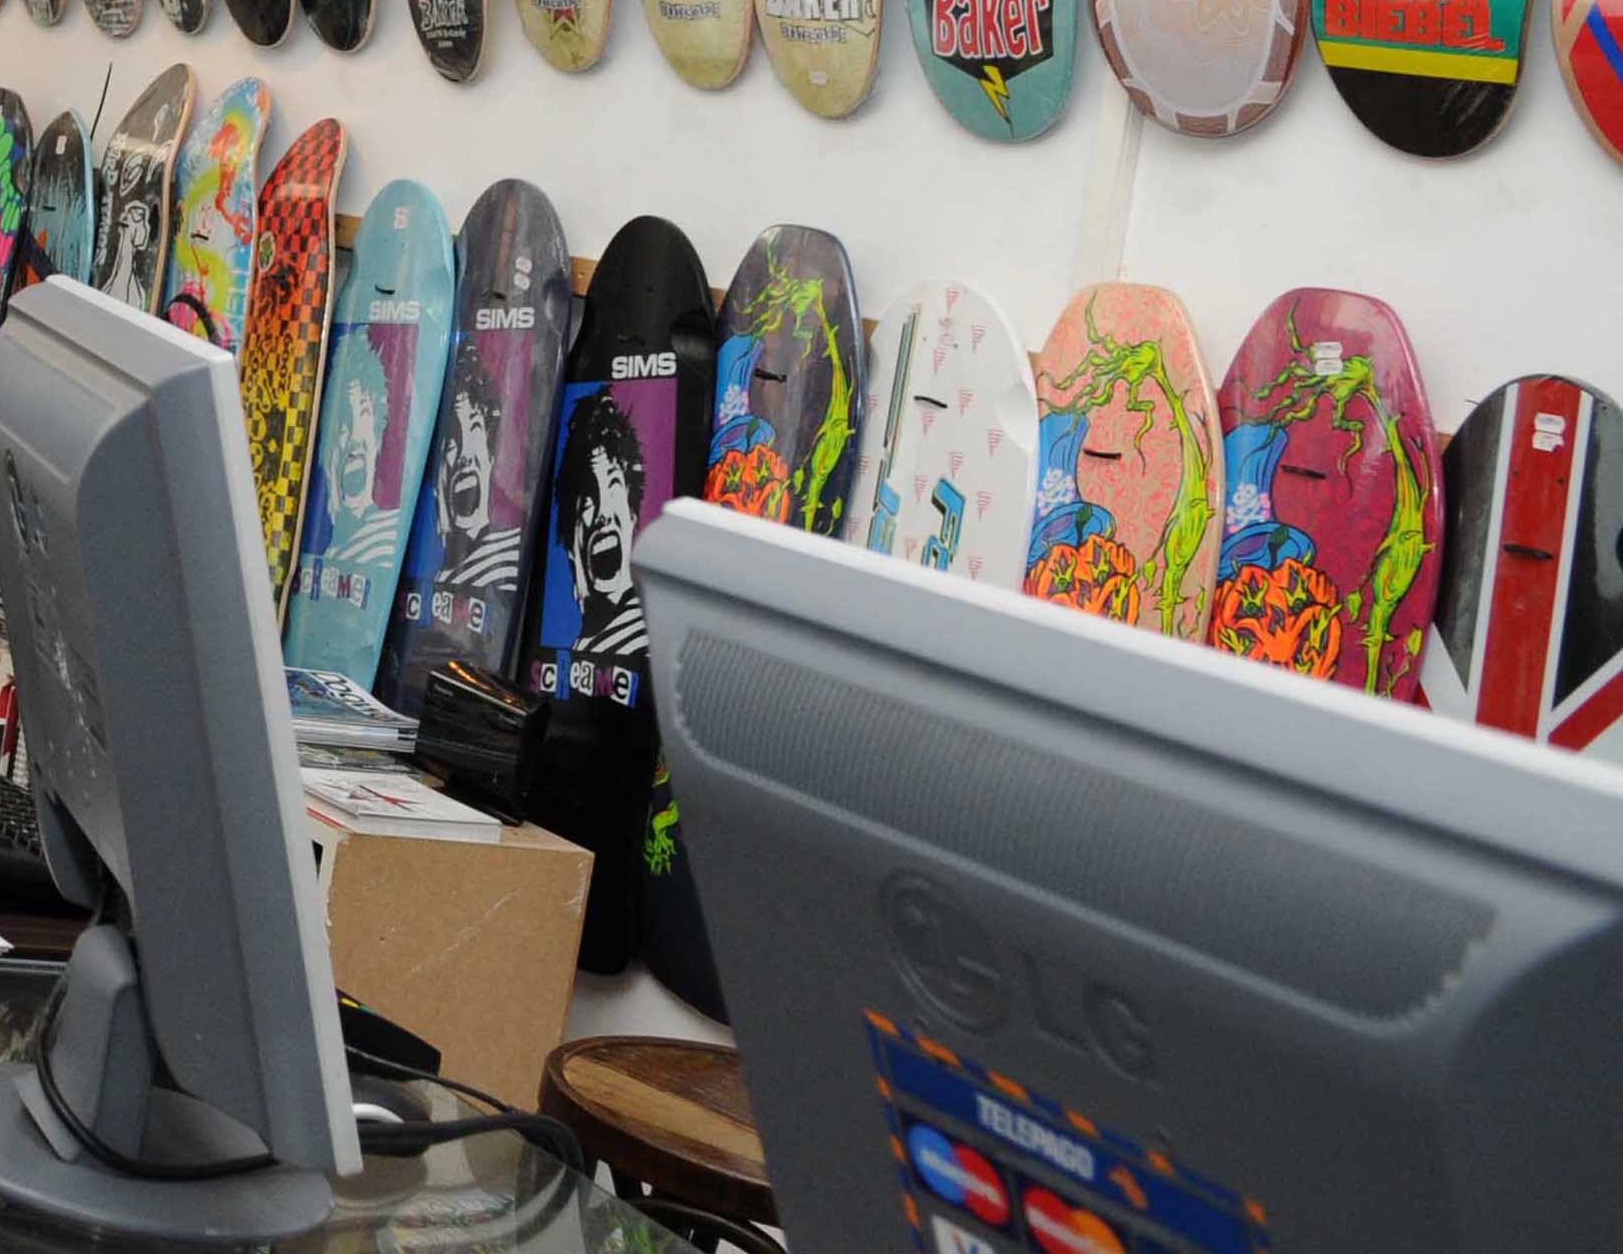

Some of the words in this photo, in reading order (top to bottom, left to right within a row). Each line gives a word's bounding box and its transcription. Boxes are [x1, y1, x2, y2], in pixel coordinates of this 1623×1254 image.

[367, 299, 421, 324] SIMS
[475, 306, 536, 331] SIMS
[610, 351, 678, 380] SIMS
[974, 1092, 1096, 1182] TELEPAGO
